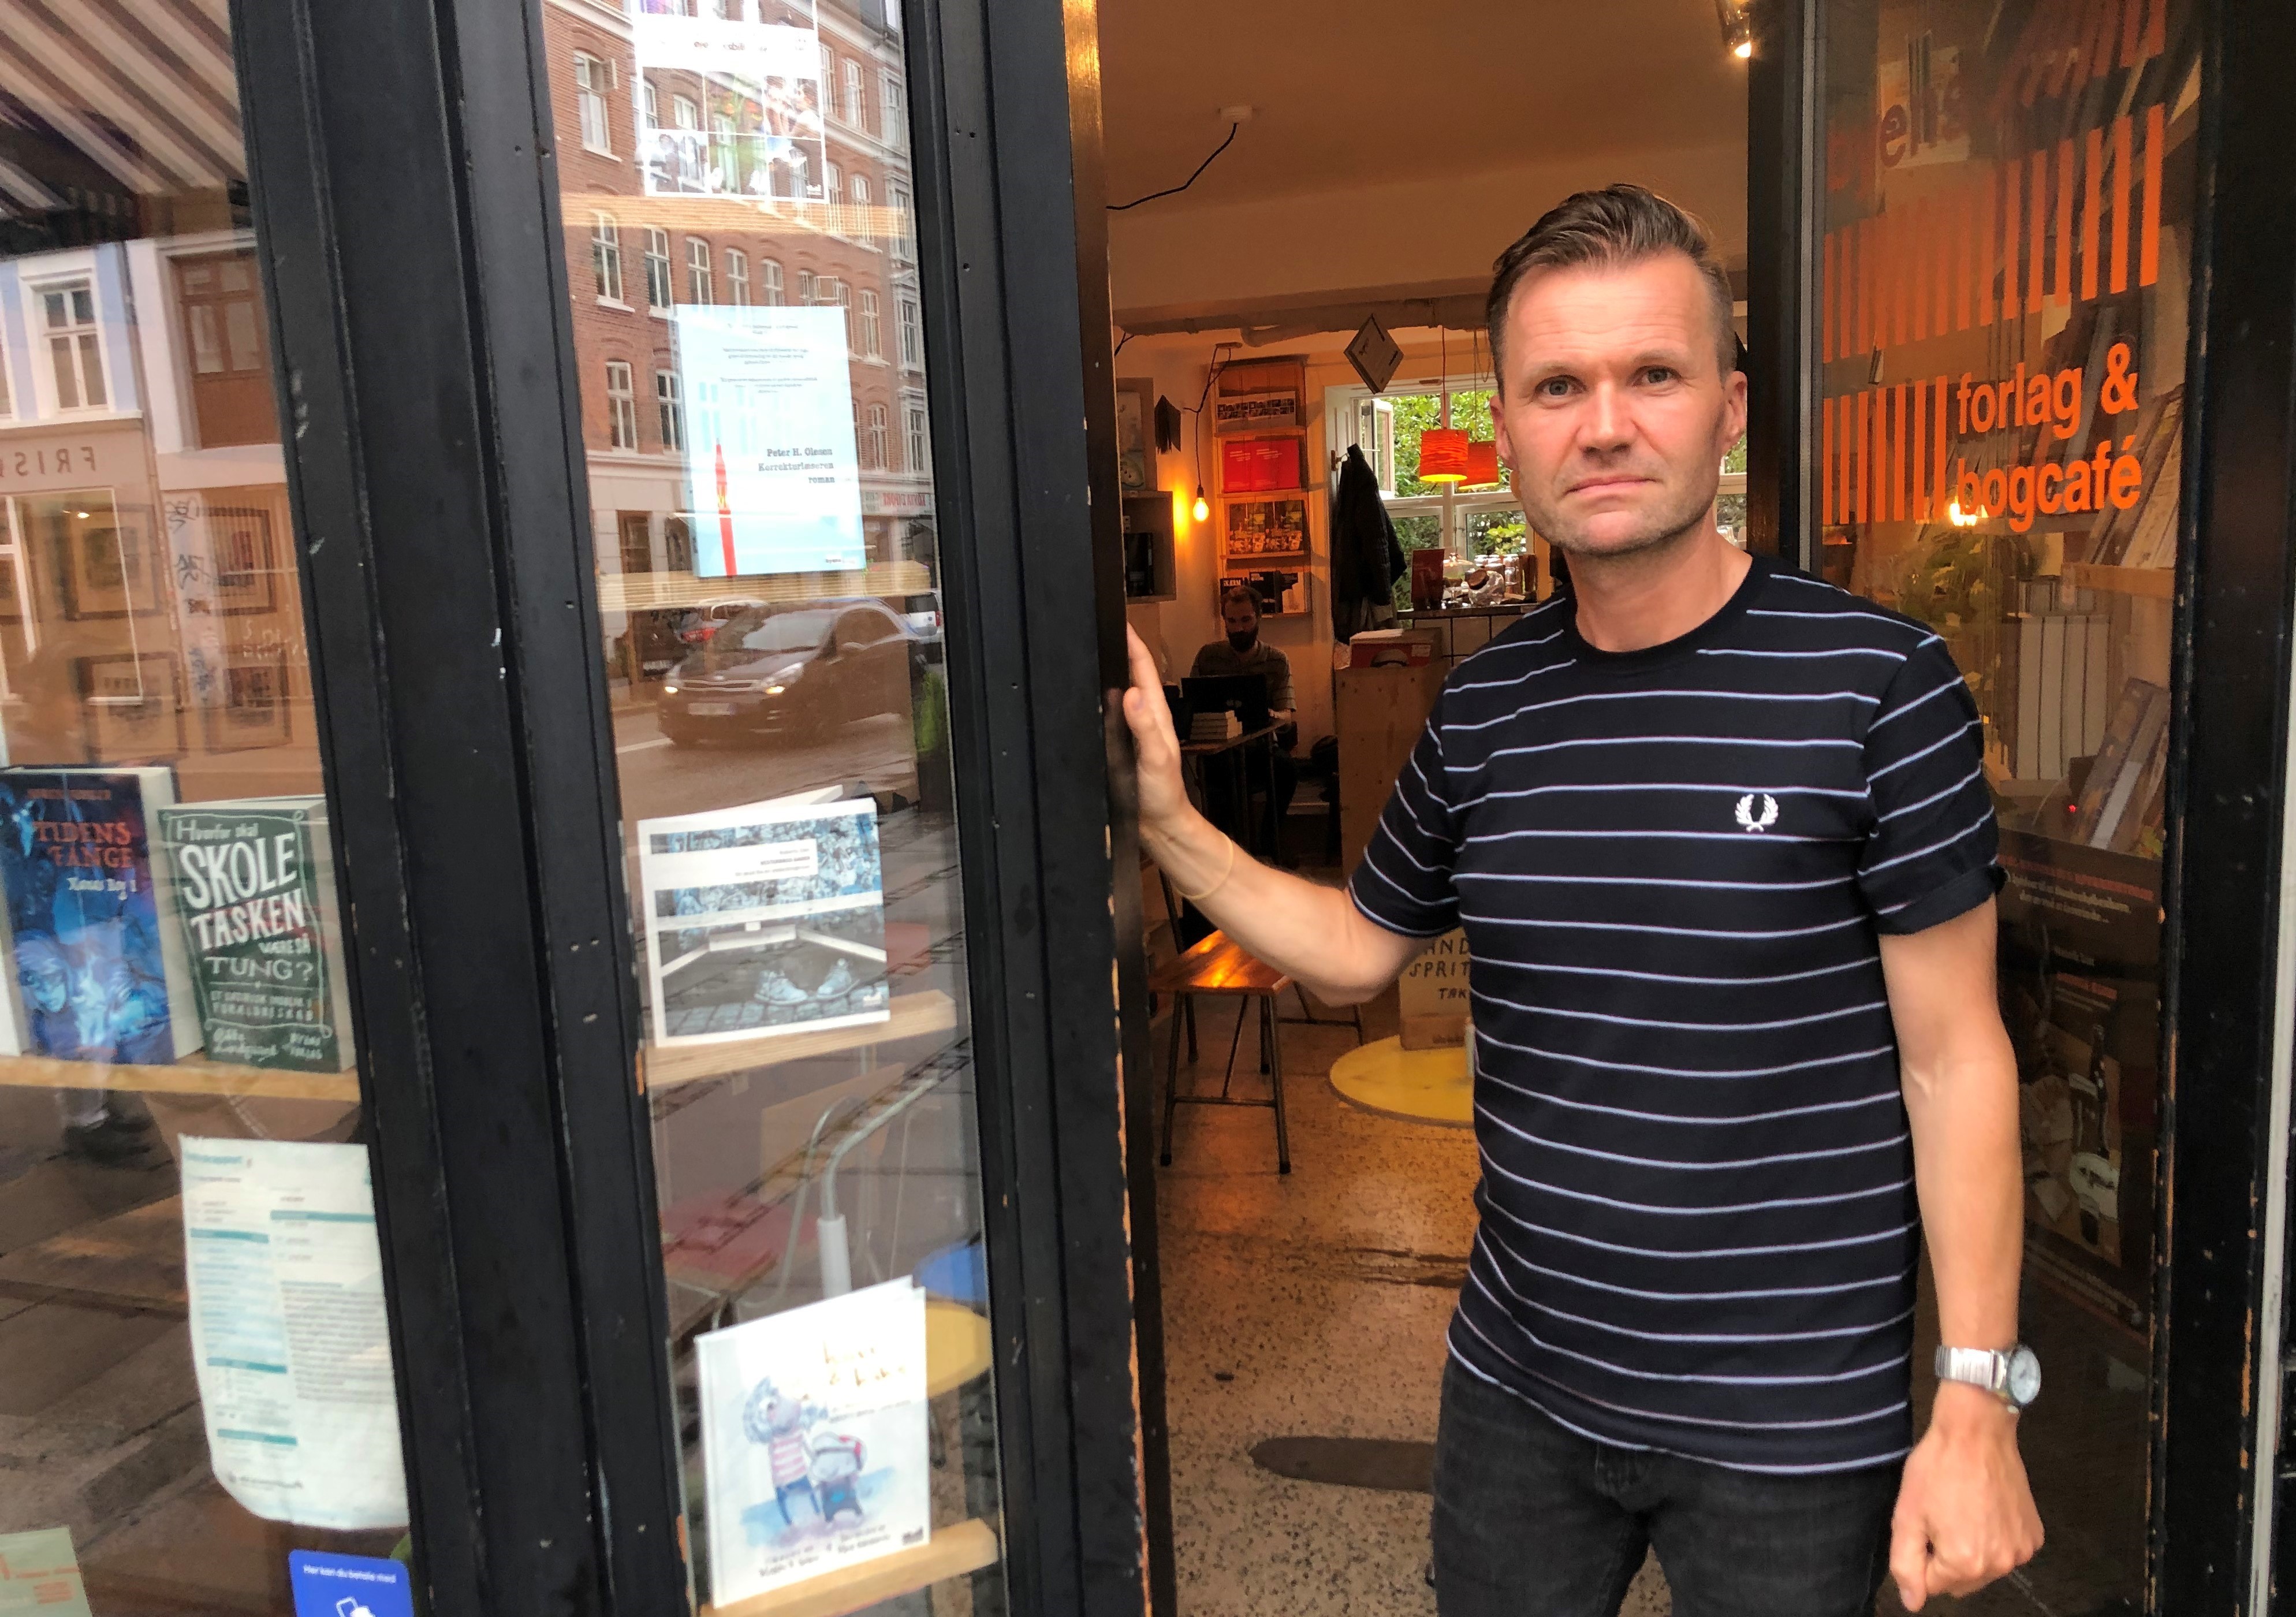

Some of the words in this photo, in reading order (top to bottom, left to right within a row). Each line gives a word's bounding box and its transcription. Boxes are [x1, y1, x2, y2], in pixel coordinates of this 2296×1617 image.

[1957, 362, 2082, 439] forlag
[2101, 342, 2139, 415] &
[767, 448, 790, 457] Peter
[792, 448, 802, 456] H.
[804, 447, 833, 456] Olesen
[1956, 434, 2142, 532] bogcafé
[32, 821, 132, 845] TIDENS
[180, 832, 297, 910] SKOLE
[190, 888, 305, 950] TASKEN
[204, 957, 314, 981] TUNG?
[1409, 960, 1470, 978] SPRIT
[1438, 987, 1467, 1000] TAK
